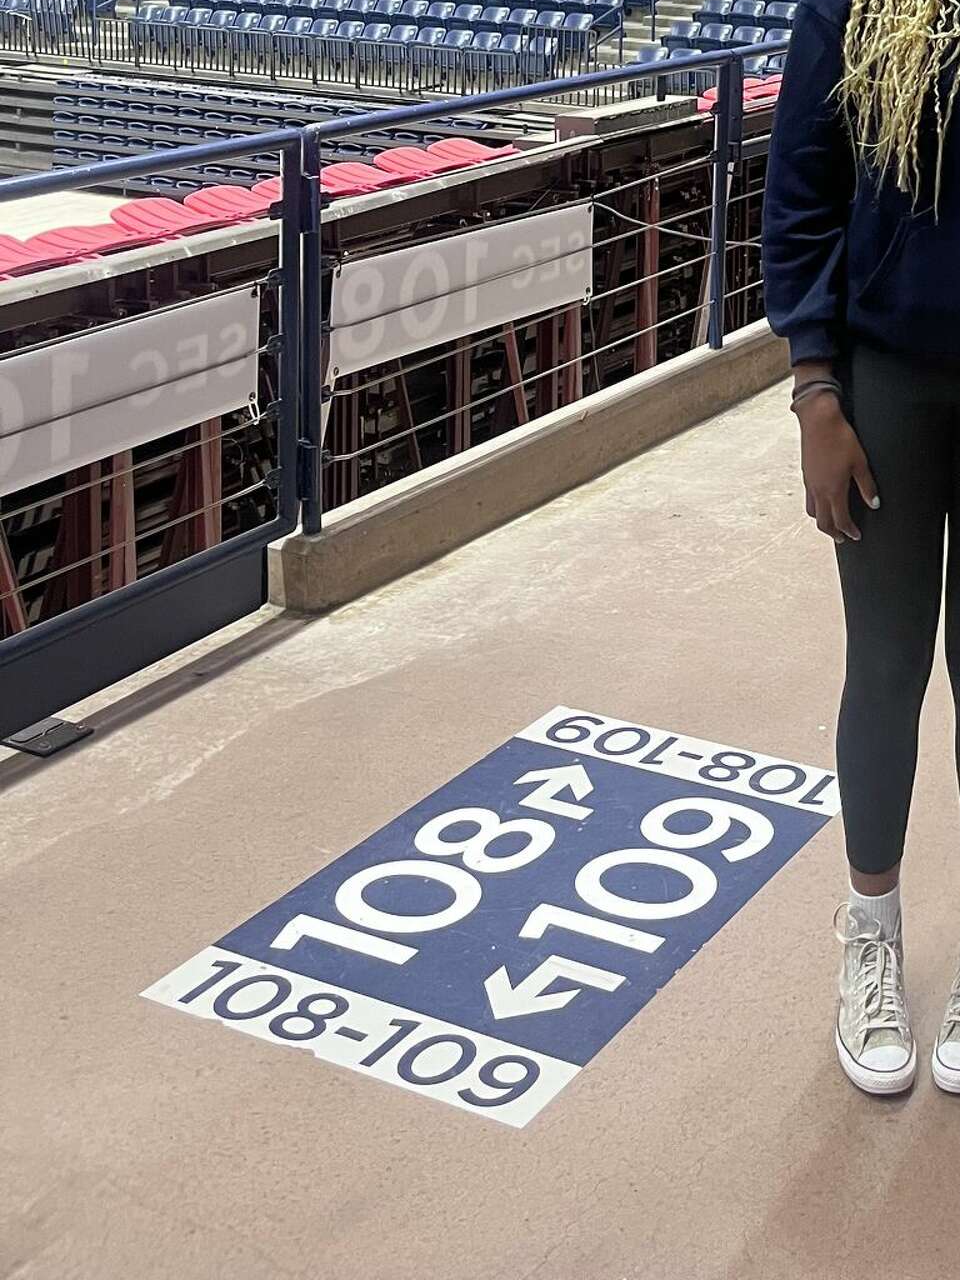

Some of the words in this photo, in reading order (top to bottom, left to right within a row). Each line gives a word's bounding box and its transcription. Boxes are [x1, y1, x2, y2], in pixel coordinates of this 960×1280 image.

[545, 715, 836, 806] 108-109
[269, 806, 556, 965] 108
[518, 796, 774, 954] 109
[177, 960, 541, 1108] 108-109
